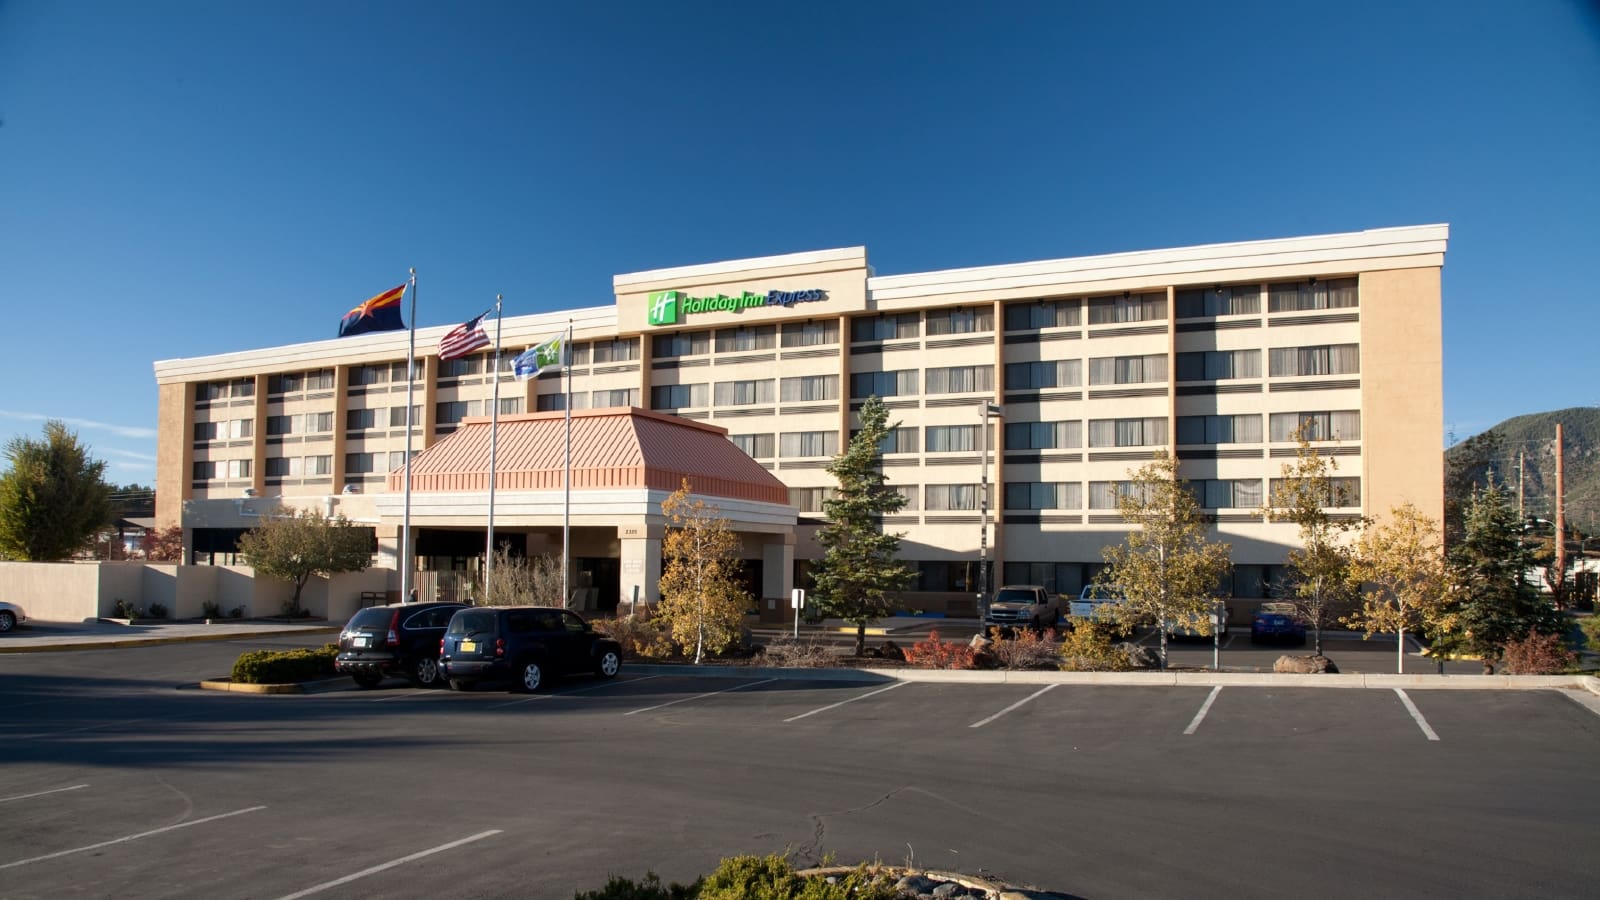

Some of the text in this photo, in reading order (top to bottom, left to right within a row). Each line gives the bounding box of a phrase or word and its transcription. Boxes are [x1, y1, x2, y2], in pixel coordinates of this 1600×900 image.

[681, 288, 821, 313] Holiday Inn Express
